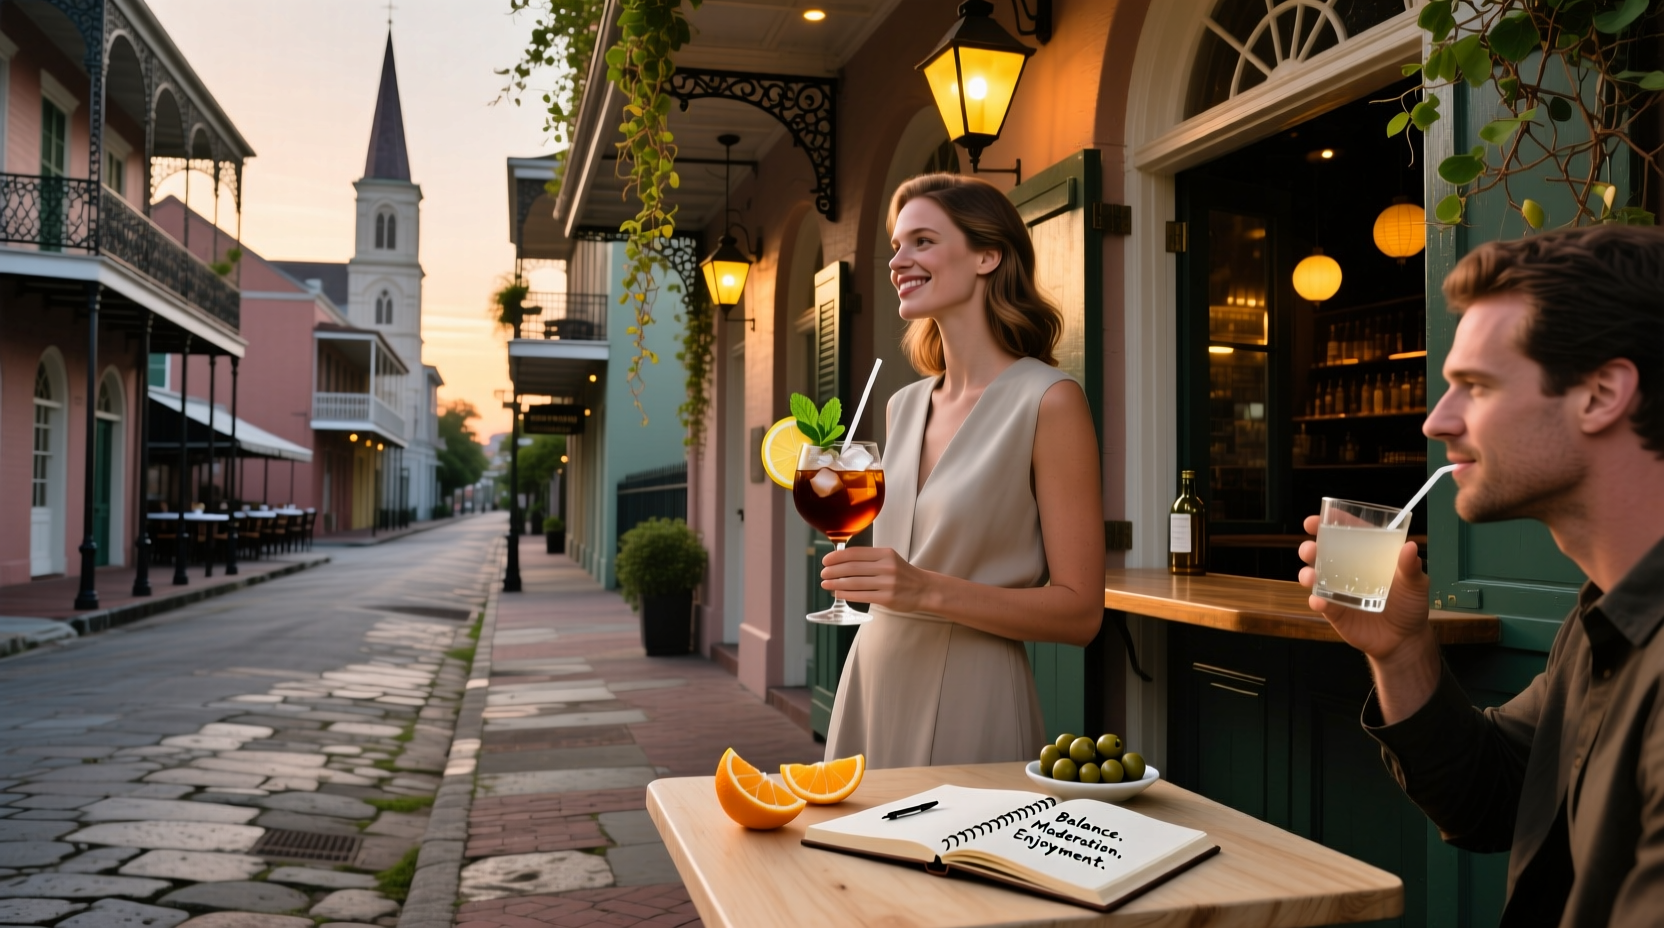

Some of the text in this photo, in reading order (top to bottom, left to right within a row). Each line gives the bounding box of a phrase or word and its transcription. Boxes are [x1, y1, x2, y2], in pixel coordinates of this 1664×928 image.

[1030, 819, 1122, 860] Moderation.
[1055, 811, 1123, 842] Balance.
[1013, 828, 1105, 870] Enjoyment.
